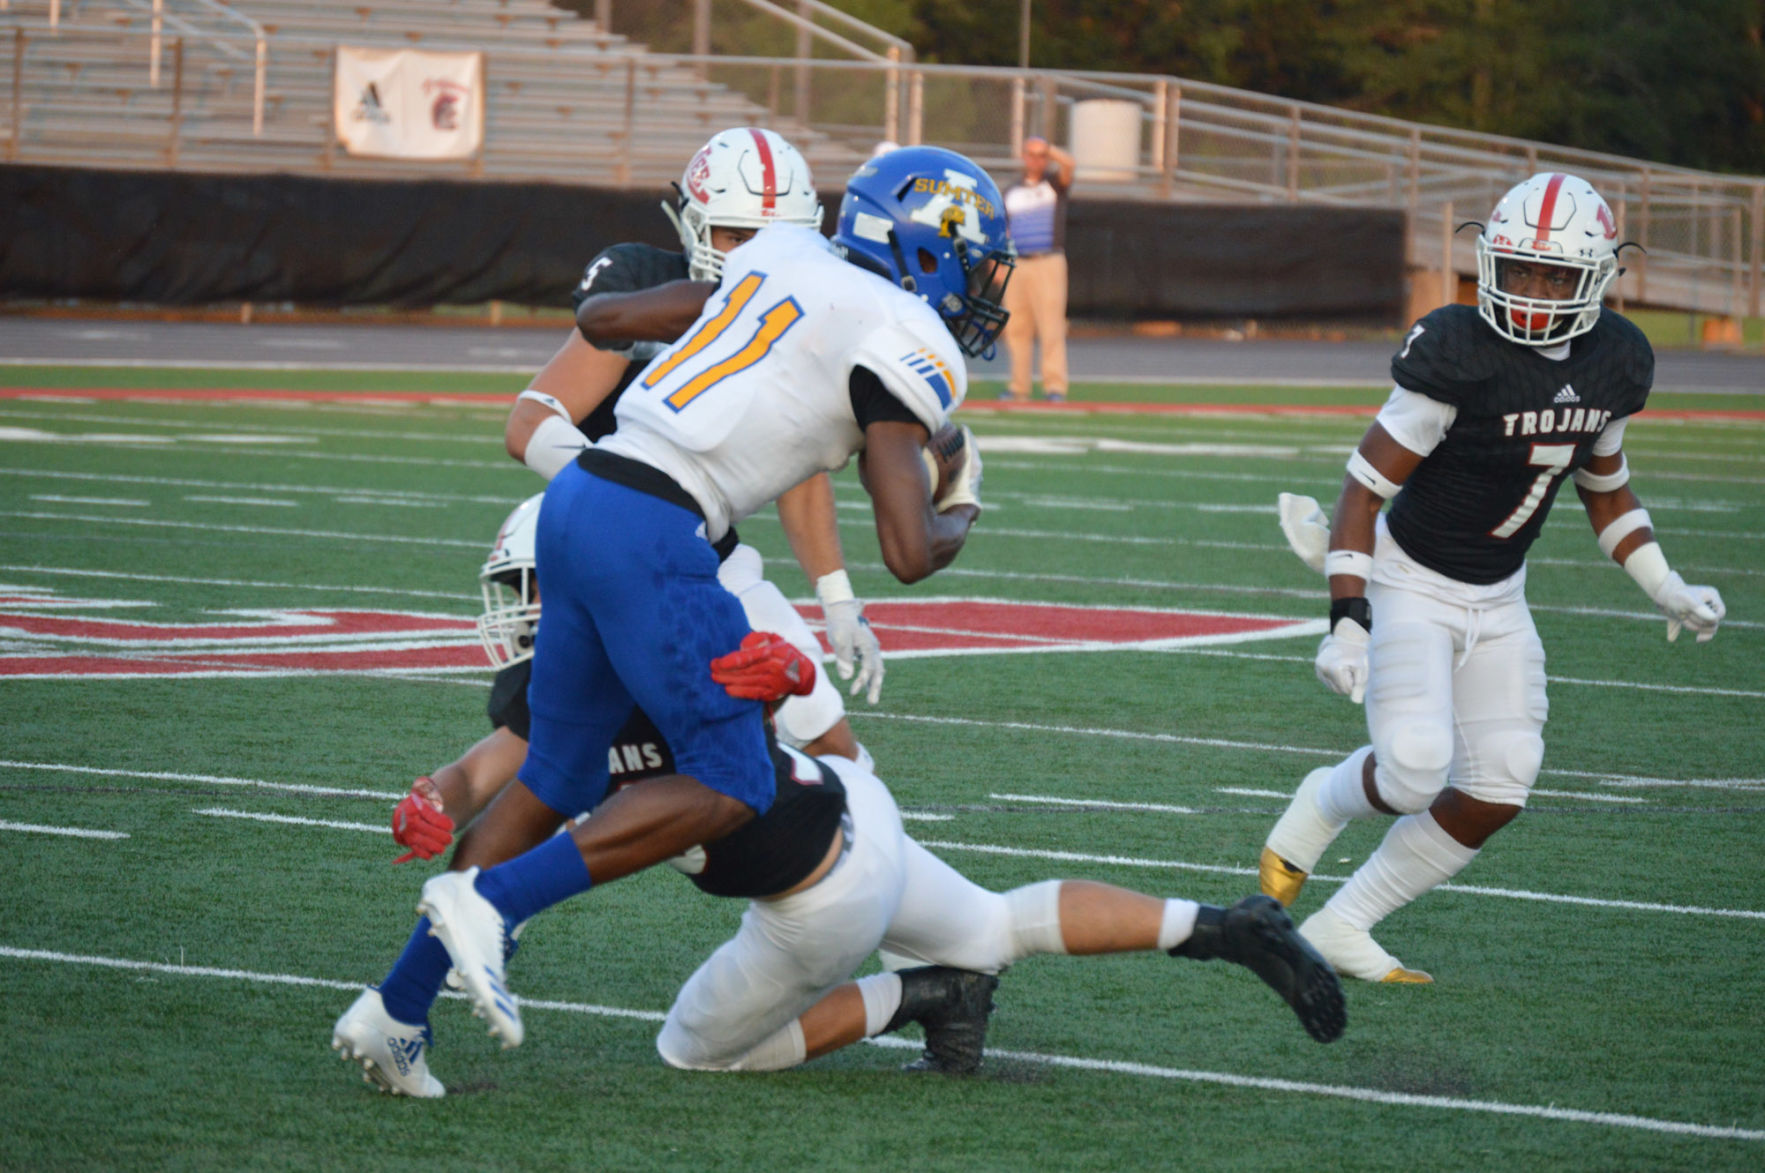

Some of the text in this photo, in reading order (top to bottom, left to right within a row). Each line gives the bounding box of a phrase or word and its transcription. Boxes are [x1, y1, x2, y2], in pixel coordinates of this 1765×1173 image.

[914, 178, 995, 220] SUMTER
[580, 256, 613, 291] 5
[640, 269, 806, 414] 11
[1400, 324, 1426, 359] 7
[1503, 408, 1612, 436] TROJANS
[1490, 442, 1577, 539] 7
